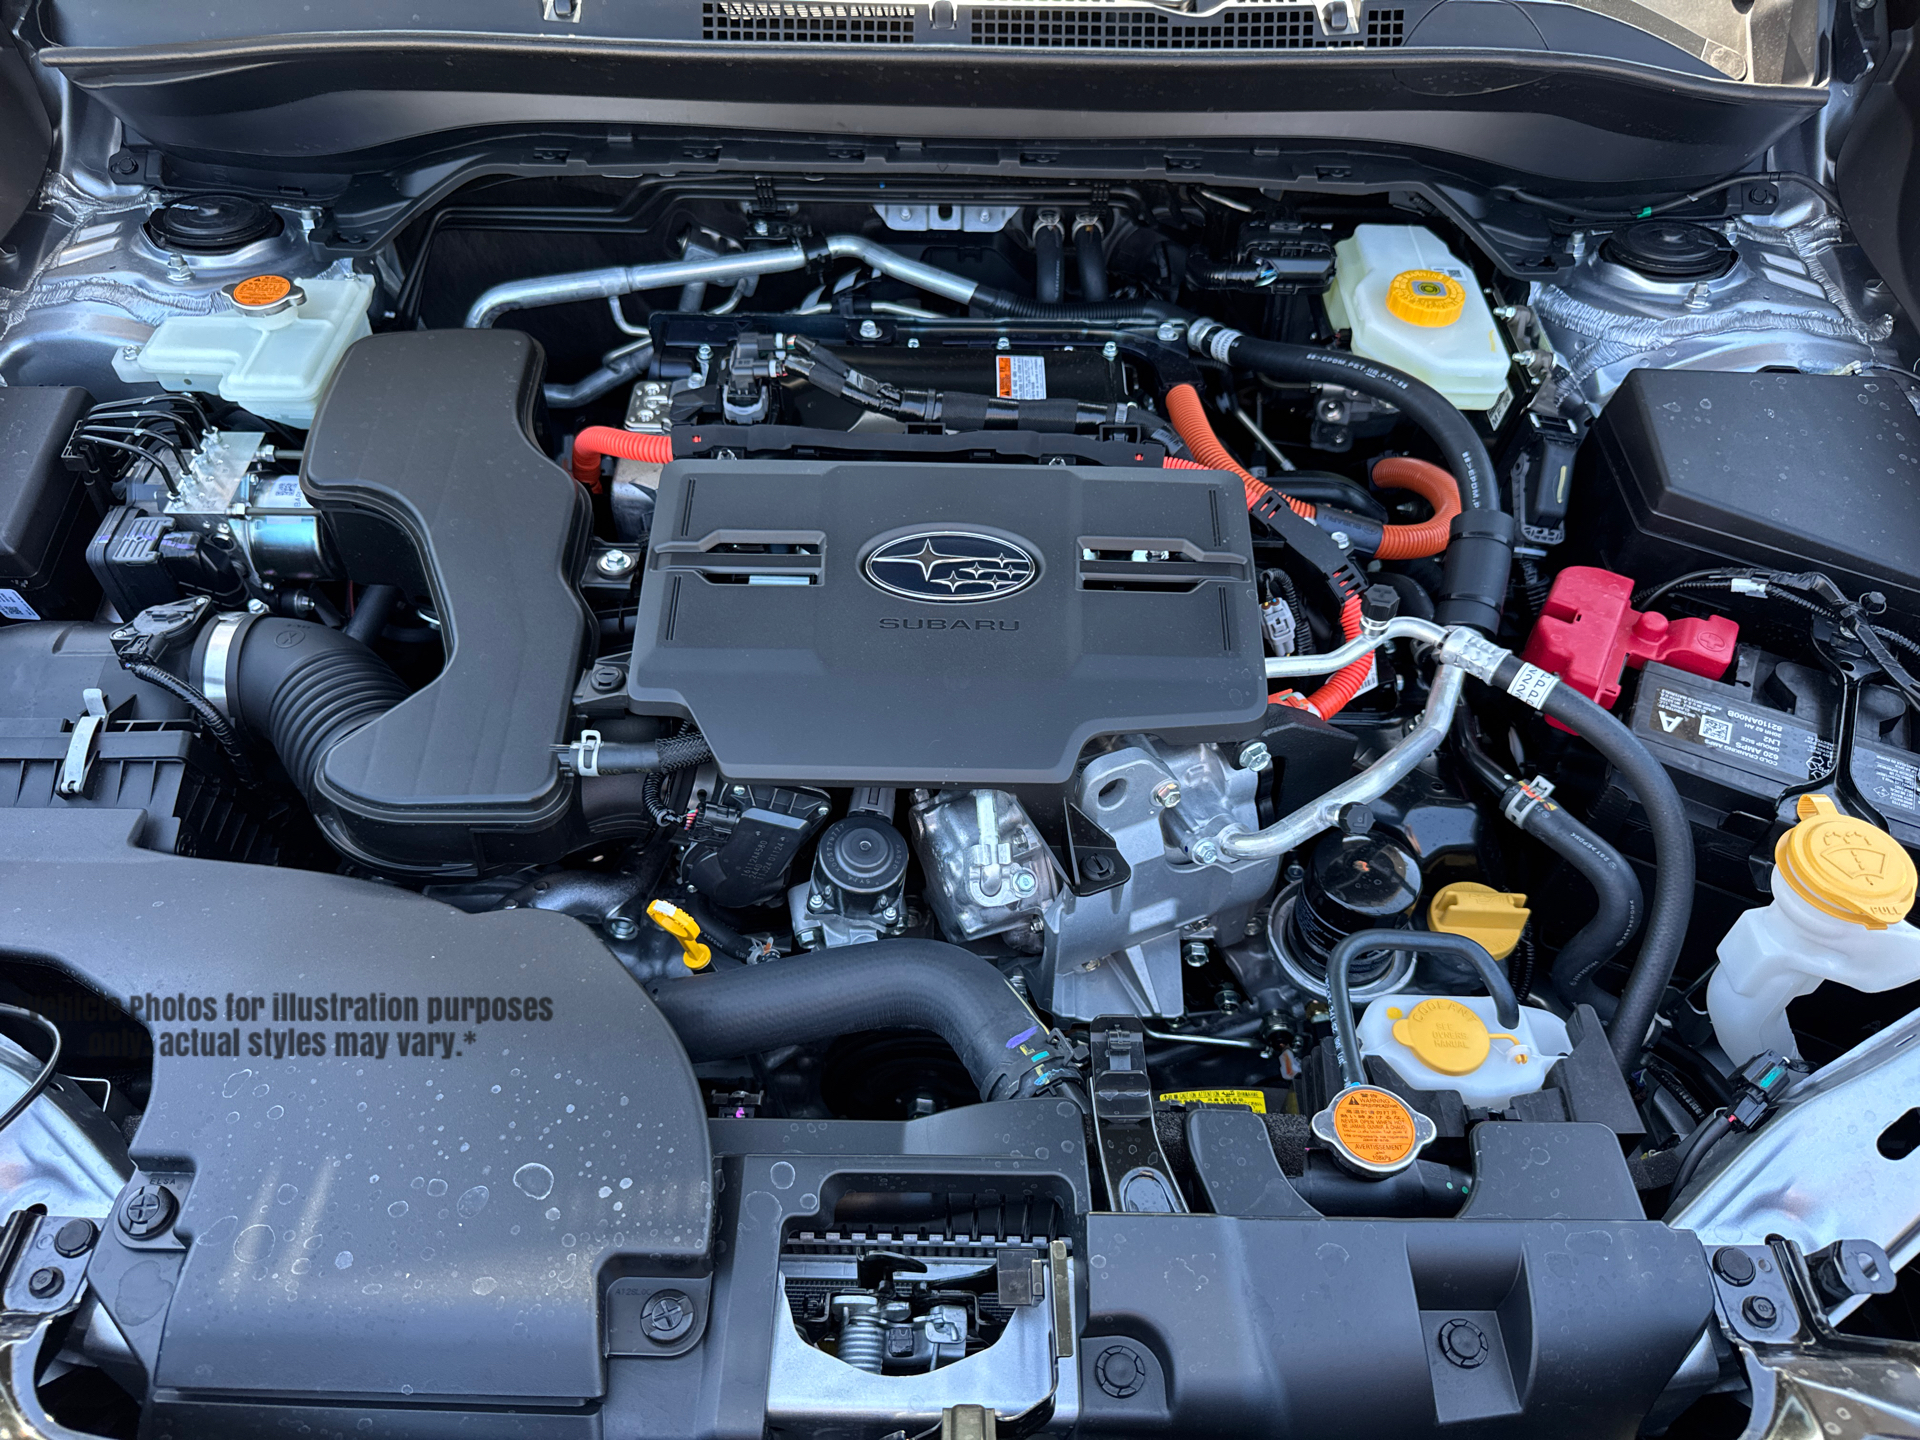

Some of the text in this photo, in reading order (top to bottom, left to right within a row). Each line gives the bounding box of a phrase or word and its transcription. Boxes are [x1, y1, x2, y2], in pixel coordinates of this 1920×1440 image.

[879, 618, 1019, 631] SUBARU
[1763, 735, 1781, 746] LN2
[1735, 741, 1779, 760] 620 AMPS
[1870, 906, 1902, 915] PULL
[1412, 1001, 1478, 1023] COOLANT
